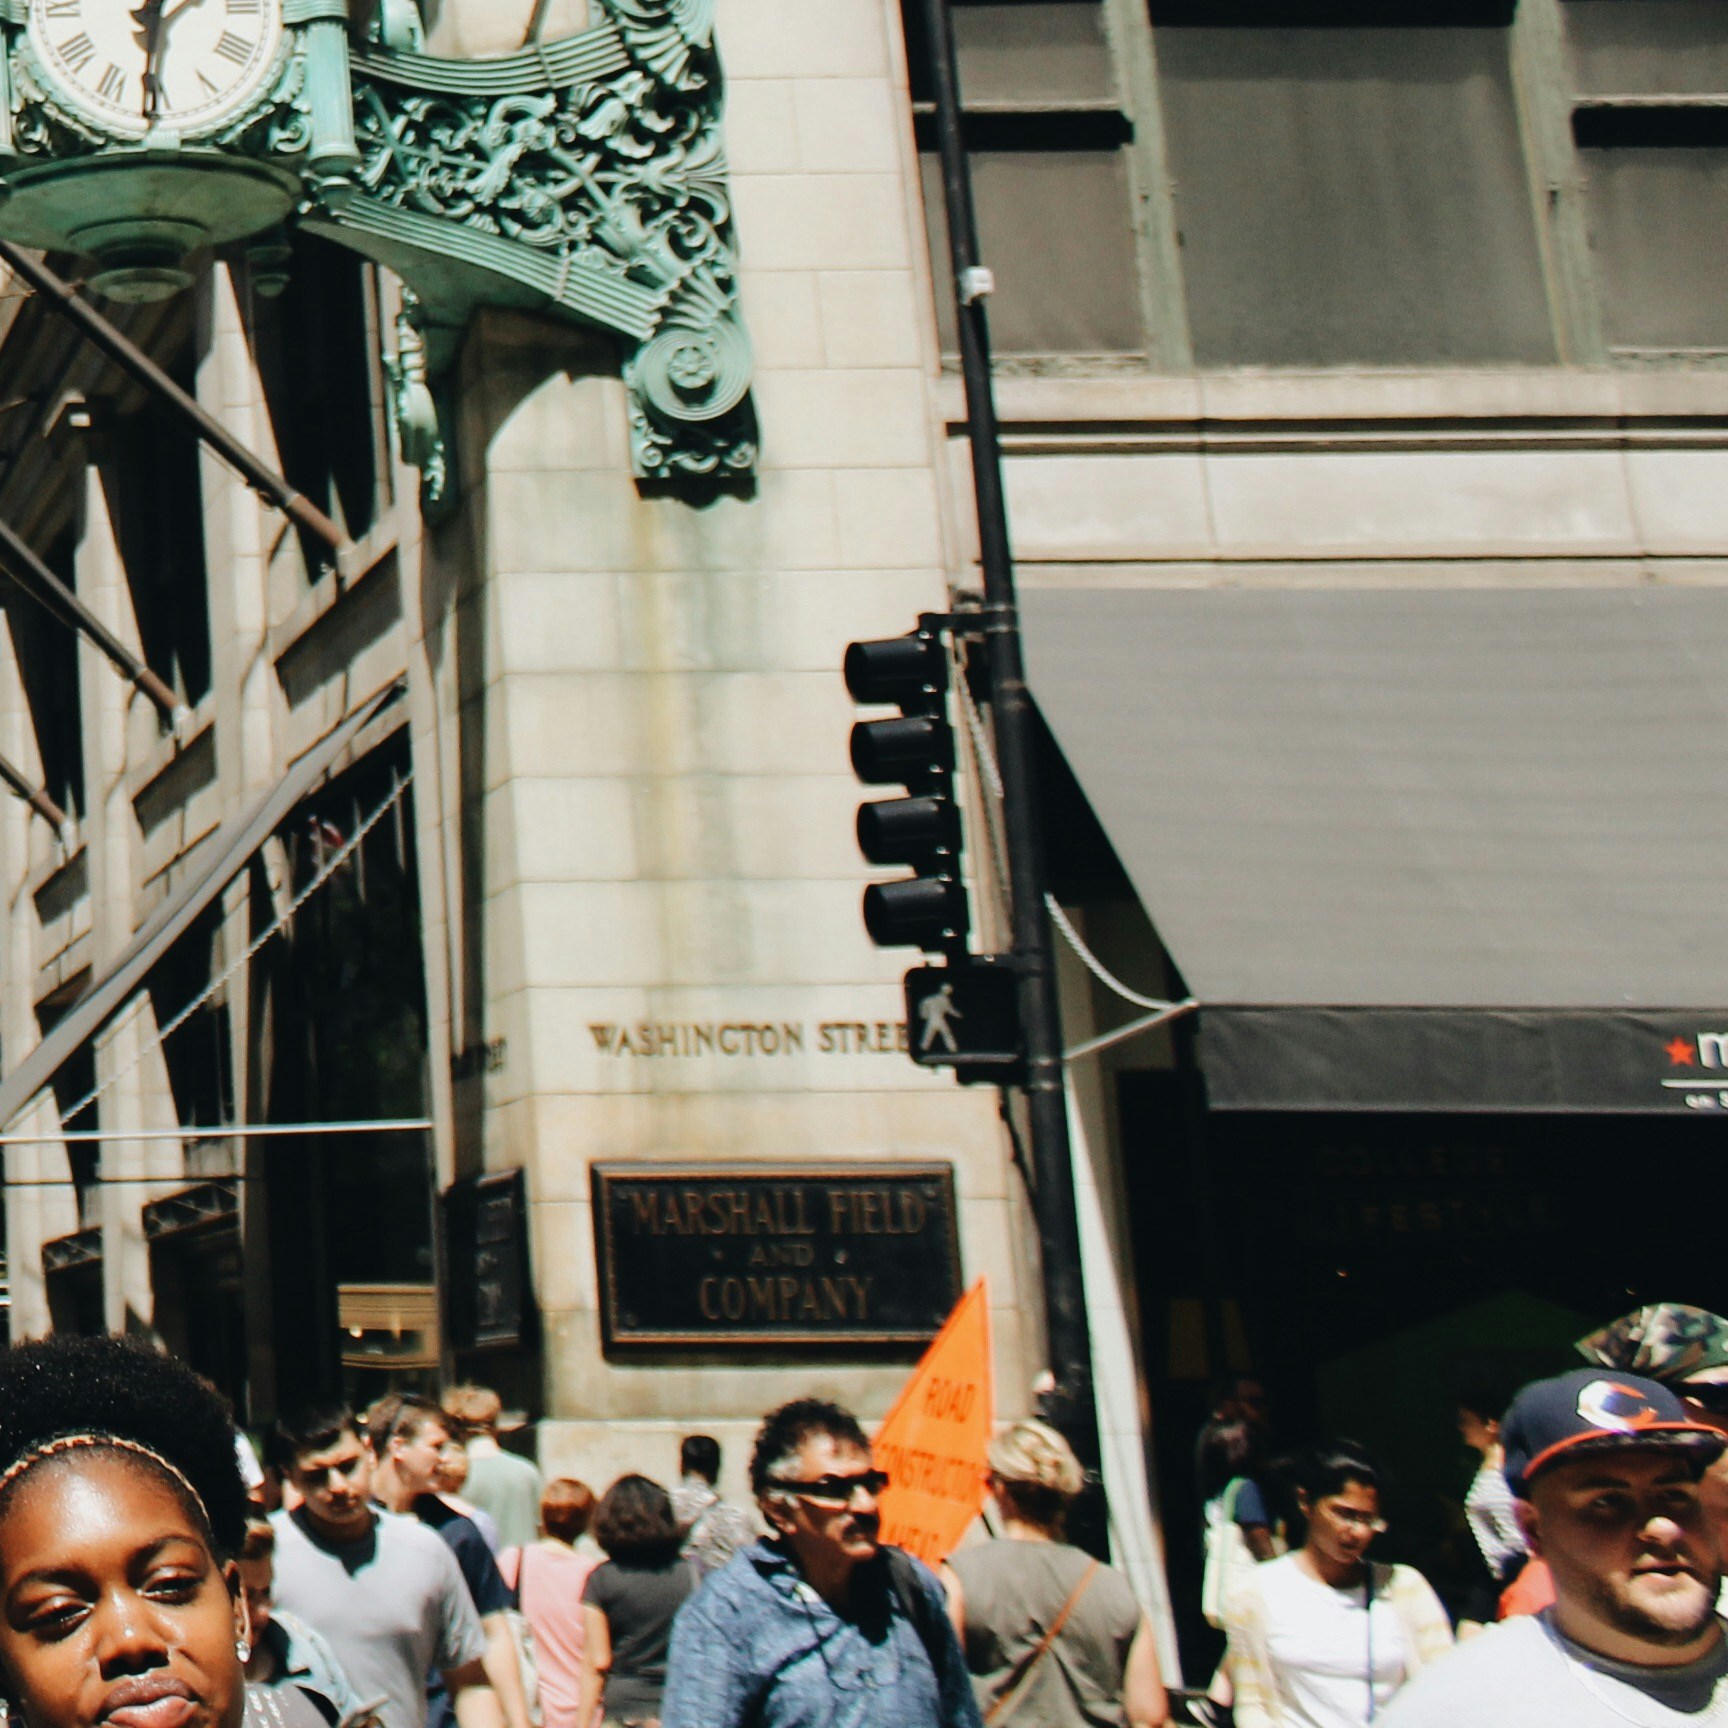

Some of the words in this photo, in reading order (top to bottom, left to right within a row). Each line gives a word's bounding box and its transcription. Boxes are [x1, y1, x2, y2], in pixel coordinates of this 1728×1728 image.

[588, 1023, 805, 1057] WASHINGTON
[817, 1023, 908, 1054] STREE
[629, 1190, 816, 1235] MARSHALL
[828, 1190, 927, 1235] FIELD
[749, 1242, 816, 1267] AND
[698, 1276, 873, 1321] COMPANY
[924, 1377, 976, 1424] ROAD
